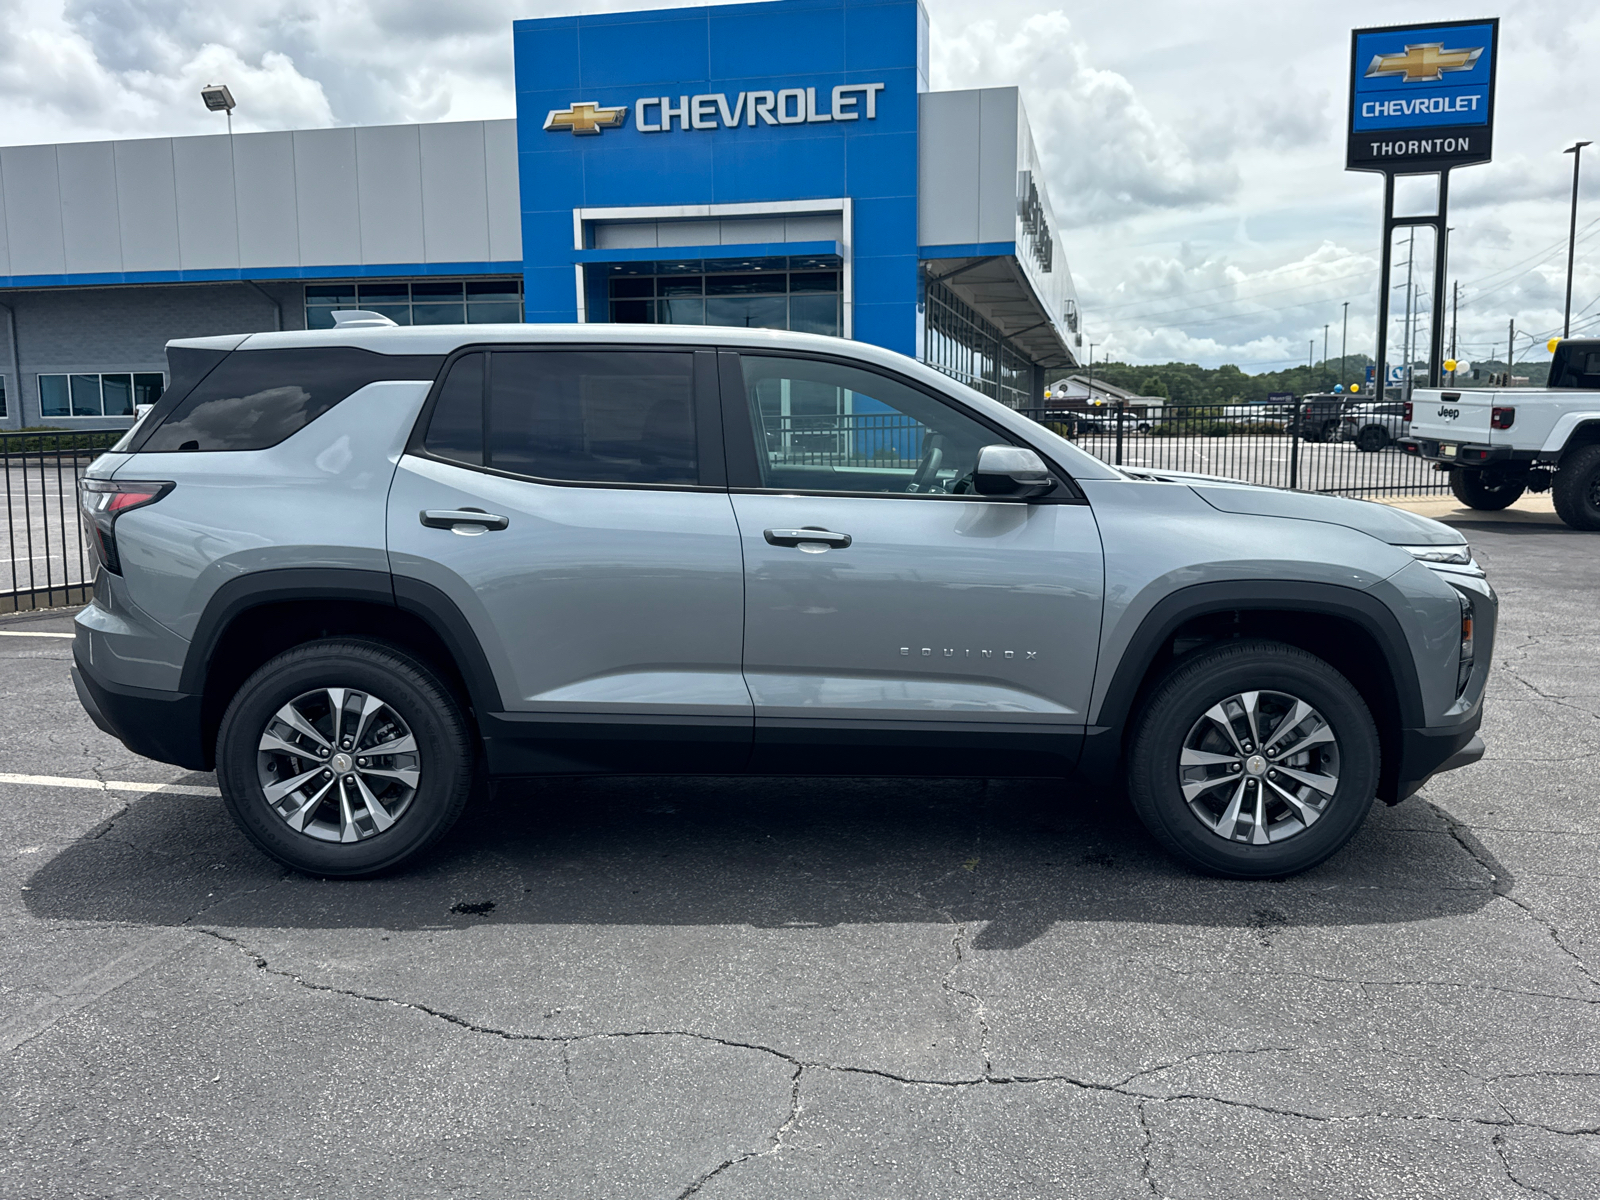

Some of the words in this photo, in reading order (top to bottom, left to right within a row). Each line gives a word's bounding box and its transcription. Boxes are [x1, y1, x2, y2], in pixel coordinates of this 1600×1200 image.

[635, 82, 885, 132] CHEVROLET
[1362, 95, 1481, 117] CHEVROLET
[1370, 137, 1470, 156] THORNTON
[1437, 405, 1460, 420] Jeep
[900, 647, 1037, 660] EQUINOX
